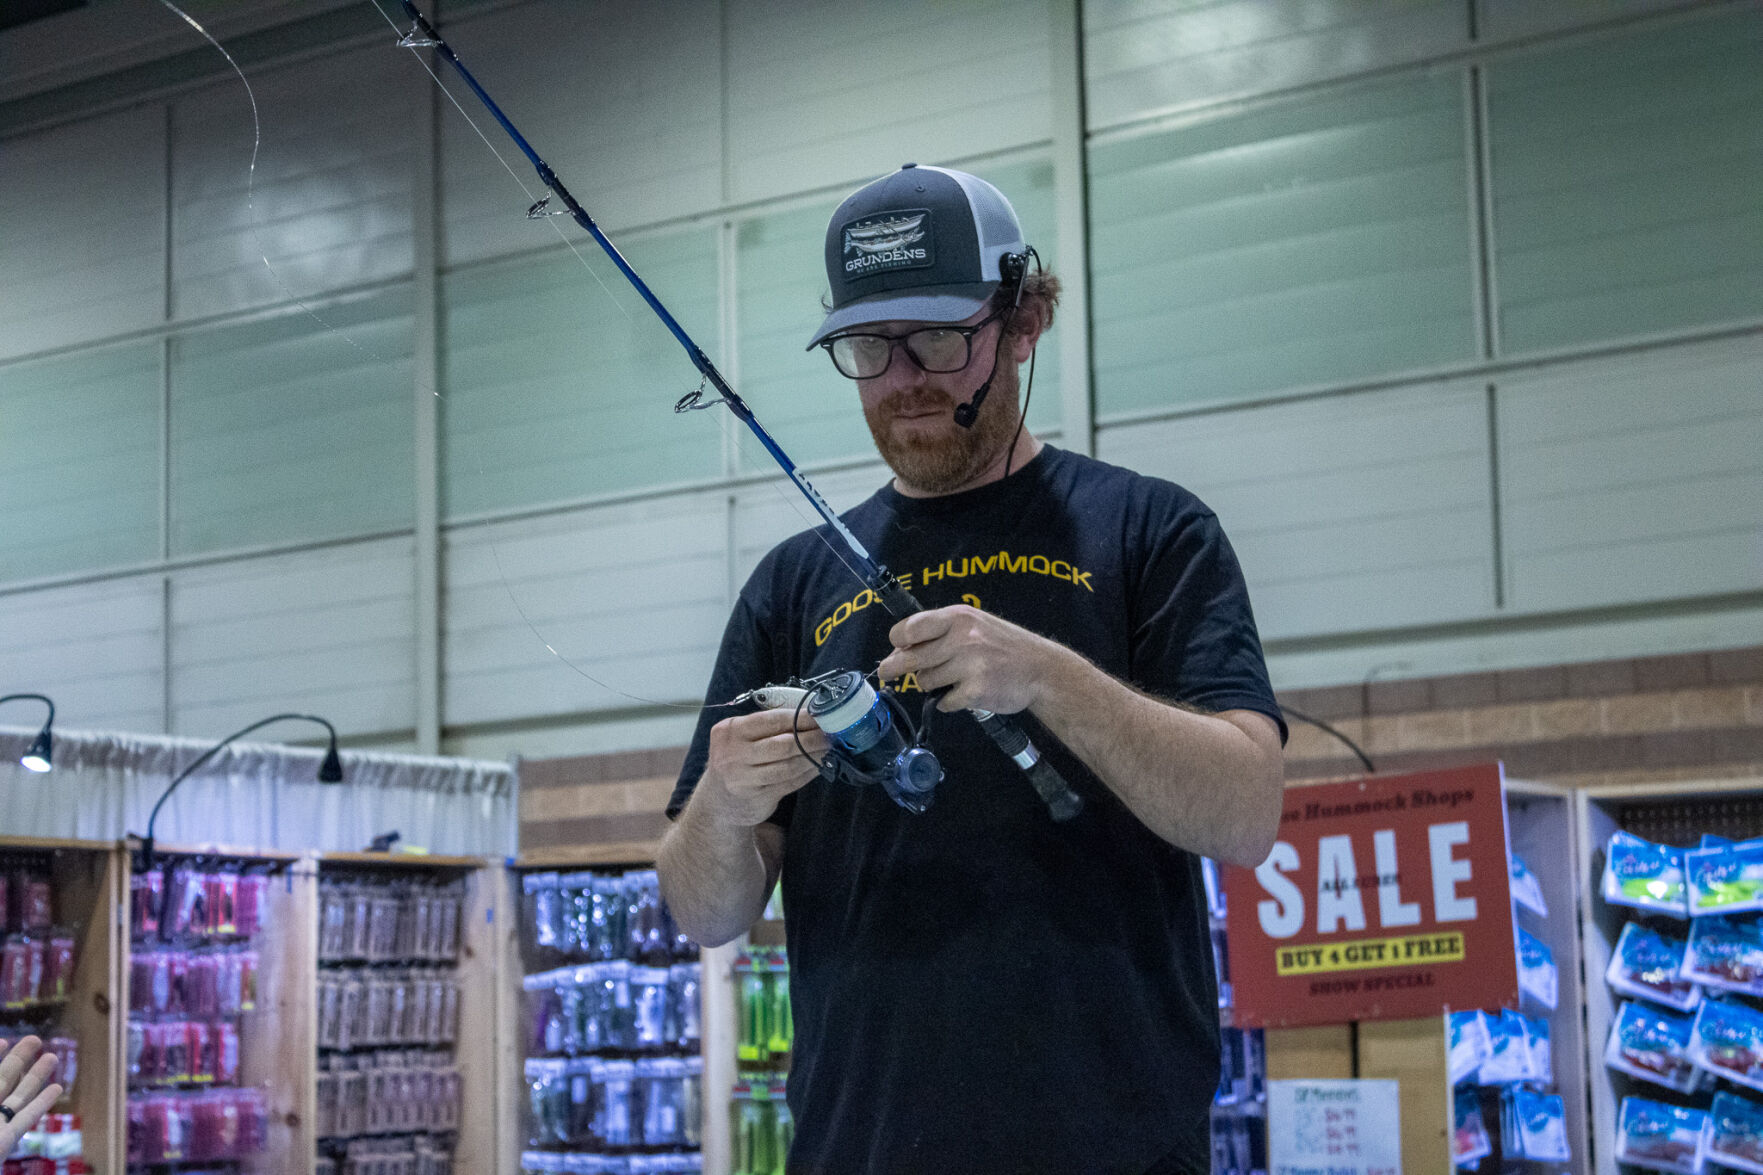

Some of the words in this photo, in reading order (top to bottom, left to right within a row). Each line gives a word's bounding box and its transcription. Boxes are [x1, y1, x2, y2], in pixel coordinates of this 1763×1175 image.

[815, 573, 912, 647] GOOE
[923, 551, 1094, 592] HUMMOCK
[1305, 798, 1406, 820] Hummock
[1412, 789, 1474, 808] Shops
[1255, 821, 1477, 938] SALE
[1281, 950, 1324, 969] BUY
[1329, 950, 1341, 965] 4
[1344, 944, 1386, 962] GET
[1404, 936, 1461, 957] FREE
[1309, 979, 1360, 995] SHOW
[1364, 972, 1434, 991] SPECIAL
